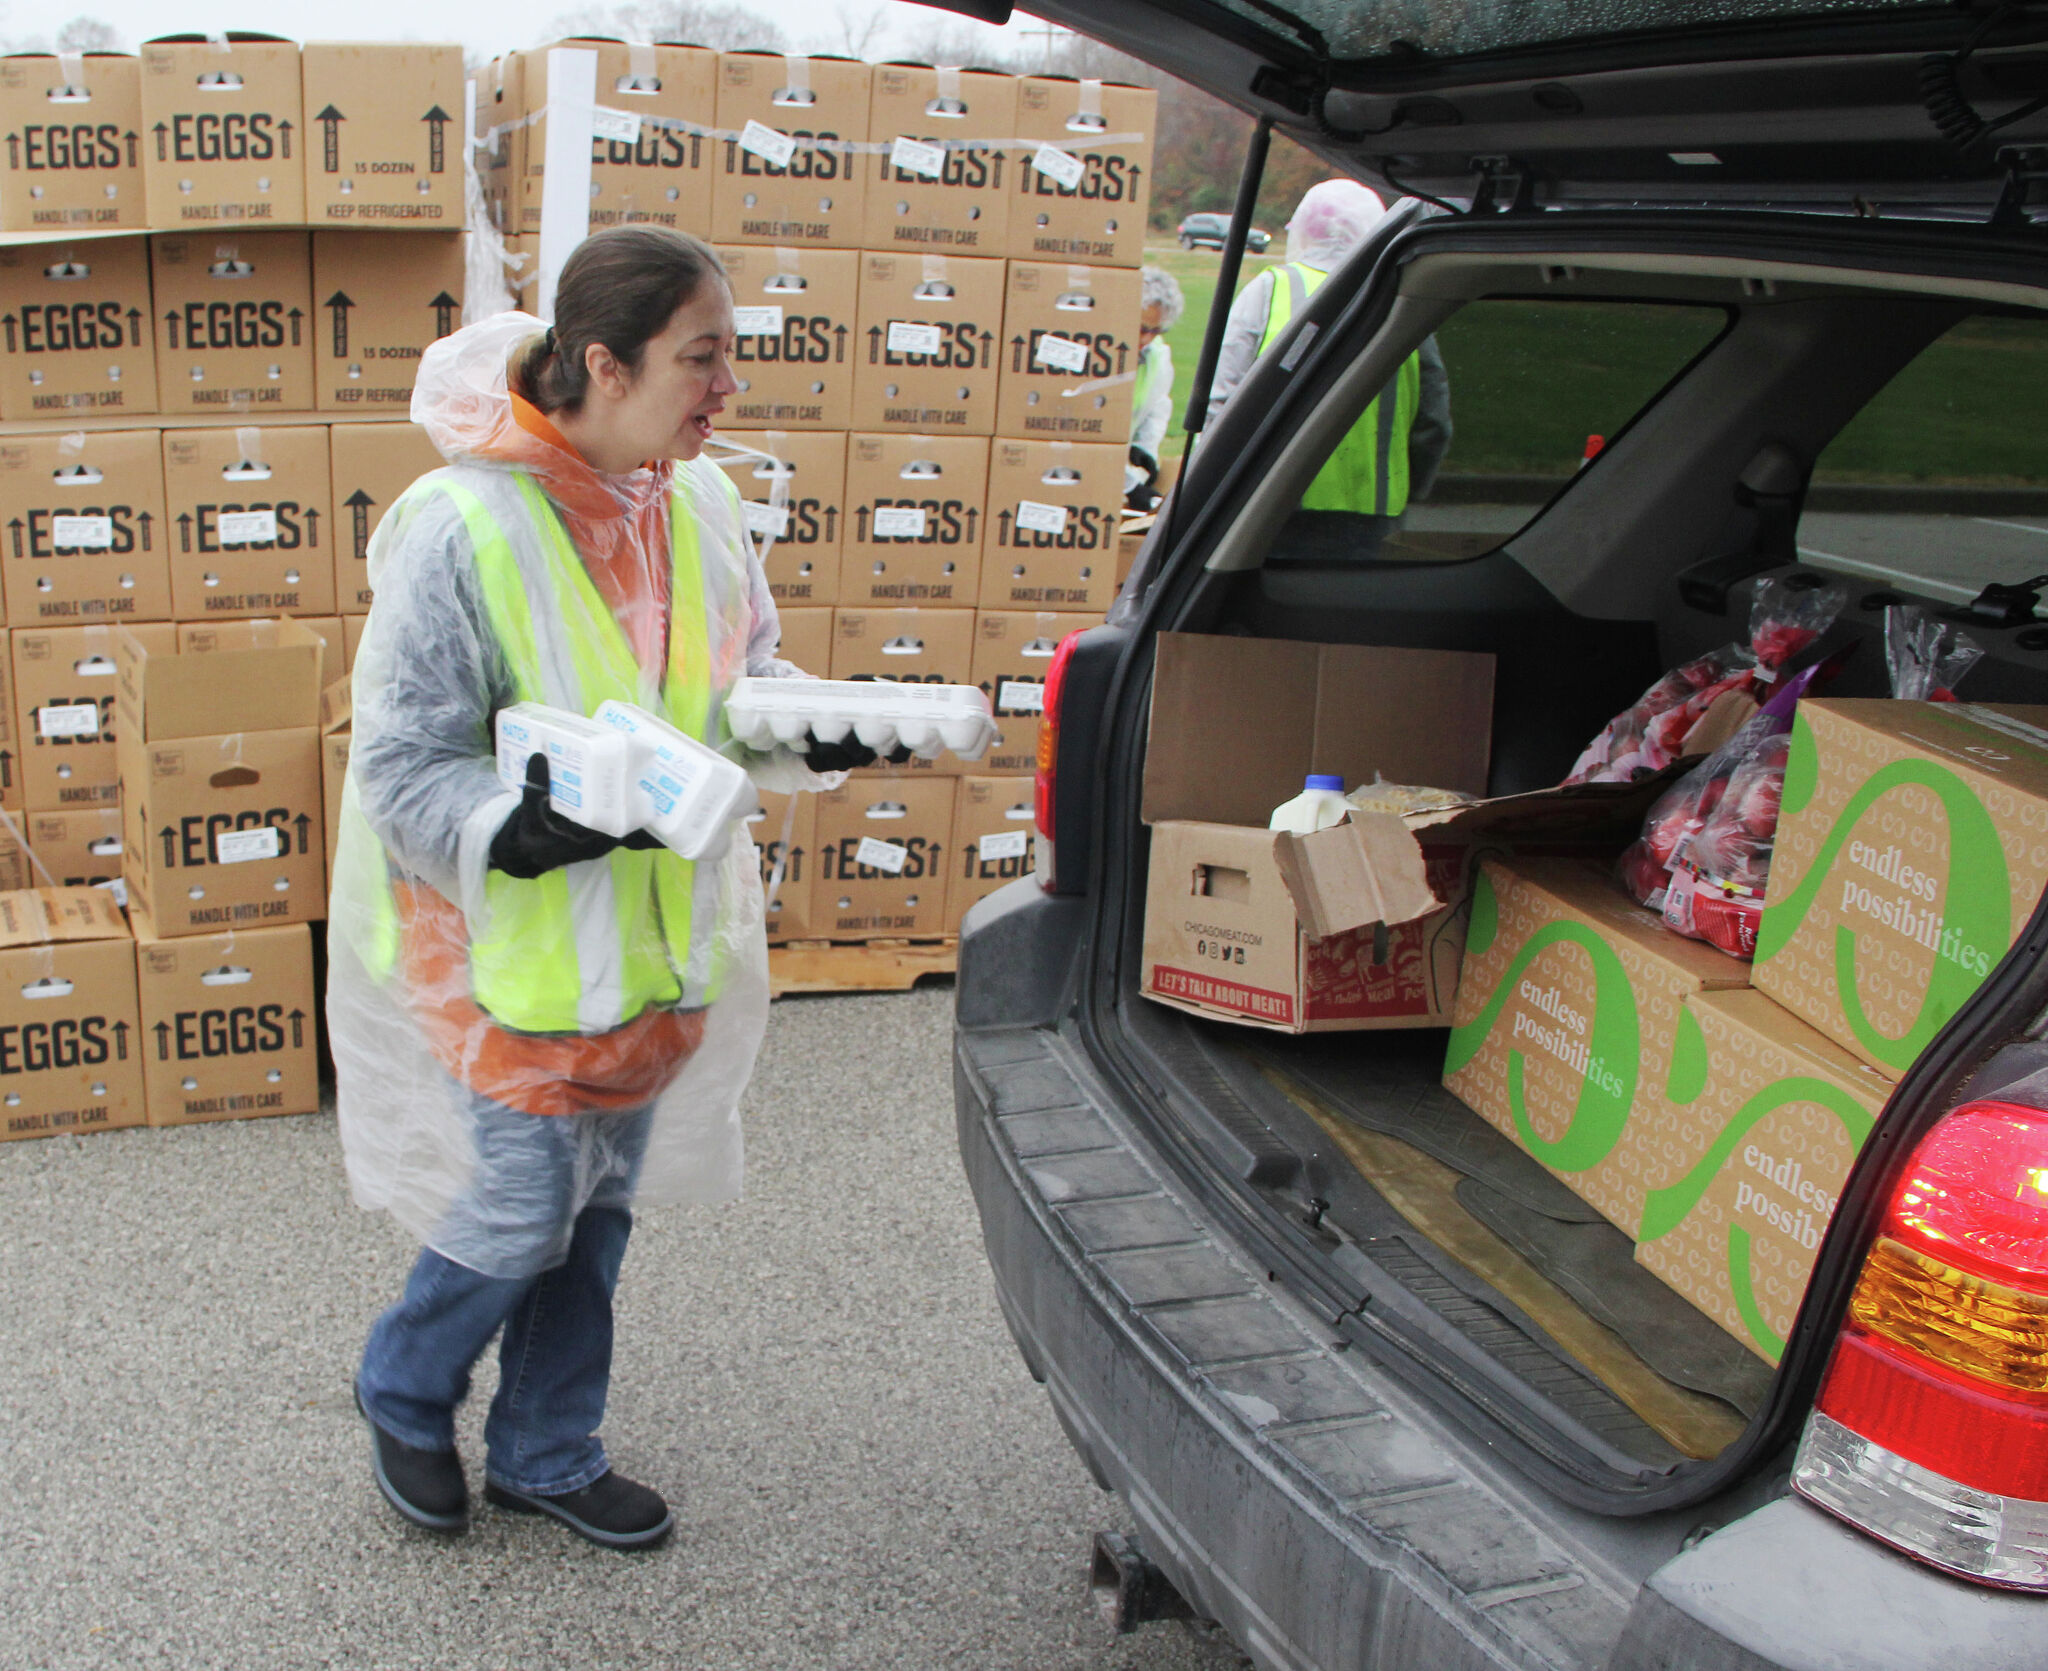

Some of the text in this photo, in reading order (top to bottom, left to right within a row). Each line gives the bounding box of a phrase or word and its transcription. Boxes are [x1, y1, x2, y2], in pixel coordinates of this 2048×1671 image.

[173, 112, 273, 162] EGGS
[24, 124, 120, 170] EGGS
[355, 162, 415, 173] 15 DOZEN
[32, 208, 120, 224] HANDLE WITH CARE
[181, 203, 272, 220] HANDLE WITH CARE
[326, 204, 443, 219] KEEP REFRIGERATED
[742, 221, 830, 239] HANDLE WITH CARE
[894, 226, 978, 245] HANDLE WITH CARE
[1034, 238, 1115, 257] HANDLE WITH CARE
[21, 302, 123, 353] EGGS
[185, 301, 284, 349] EGGS
[363, 347, 423, 359] 15 DOZEN
[98, 391, 124, 406] CARE
[192, 389, 229, 404] HANDLE
[258, 388, 282, 403] CARE
[336, 389, 364, 402] KEEP
[736, 404, 823, 420] HANDLE WITH CARE
[884, 408, 967, 425] HANDLE WITH CARE
[1025, 416, 1103, 433] HANDLE WITH CARE
[789, 584, 812, 598] CARE
[871, 584, 953, 599] HANDLE WITH CARE
[1010, 587, 1088, 603] HANDLE WITH CARE
[39, 598, 135, 617] HANDLE WITH CARE
[205, 592, 300, 611] HANDLE WITH CARE
[990, 755, 1021, 768] HANDLE
[1849, 840, 1938, 902] endless
[190, 900, 289, 925] HANDLE WITH CARE
[836, 916, 869, 930] HANDLE
[894, 915, 916, 928] CARE
[1840, 880, 1990, 977] possibilities
[1184, 921, 1262, 946] CHICAGOMEAT.COM
[1159, 971, 1287, 1018] LET'S TALK ABOUT MEAT!
[1520, 979, 1587, 1035] endless
[175, 1004, 284, 1060] EGGS
[0, 1016, 109, 1075] EGGS
[1512, 1011, 1624, 1098] possibilities
[185, 1092, 283, 1114] HANDLE WITH CARE
[8, 1106, 108, 1132] HANDLE WITH CARE
[1744, 1144, 1838, 1219] endless
[1734, 1181, 1827, 1249] possib
